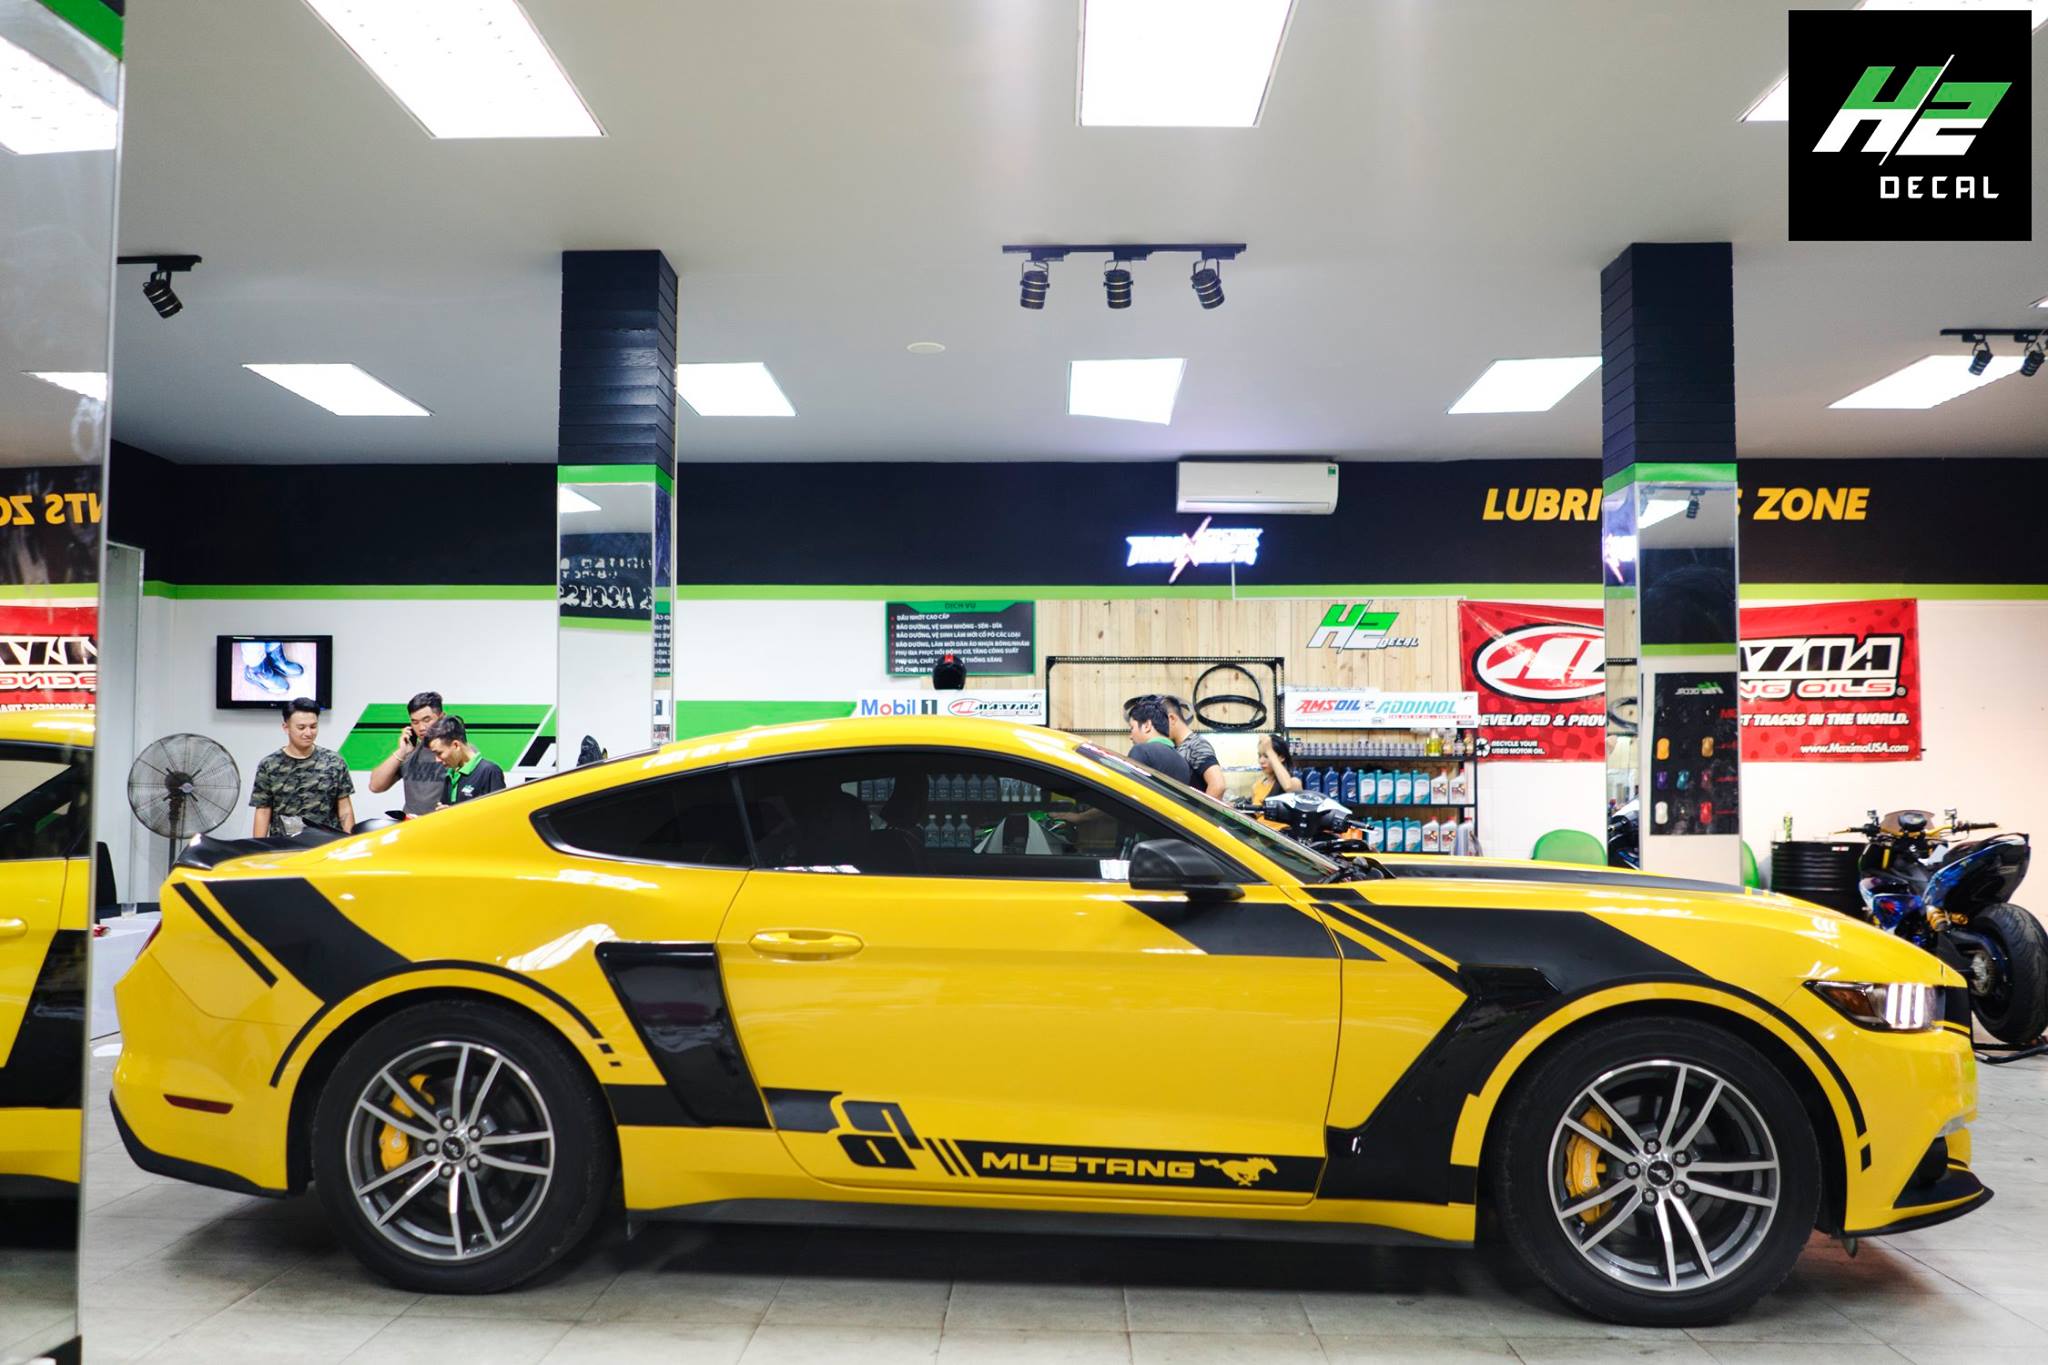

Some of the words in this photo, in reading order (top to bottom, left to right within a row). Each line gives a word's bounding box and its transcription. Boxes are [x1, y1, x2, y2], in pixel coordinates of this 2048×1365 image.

[1753, 488, 1870, 520] ZONE
[1377, 638, 1419, 649] DECAL
[1799, 681, 1893, 695] OILS
[861, 699, 916, 715] Mobil
[921, 699, 937, 715] 1
[1296, 700, 1361, 713] AMSOIL
[1376, 700, 1457, 714] ADDINOL
[1553, 714, 1565, 727] &
[1753, 713, 1806, 727] TRACKS
[1808, 713, 1825, 726] IN
[1827, 713, 1854, 726] THE
[1856, 713, 1910, 726] WORLD.
[1491, 740, 1519, 748] RECYCLE
[1800, 742, 1909, 754] www.MaximaUSA.com
[982, 1152, 1195, 1178] MUSTANG
